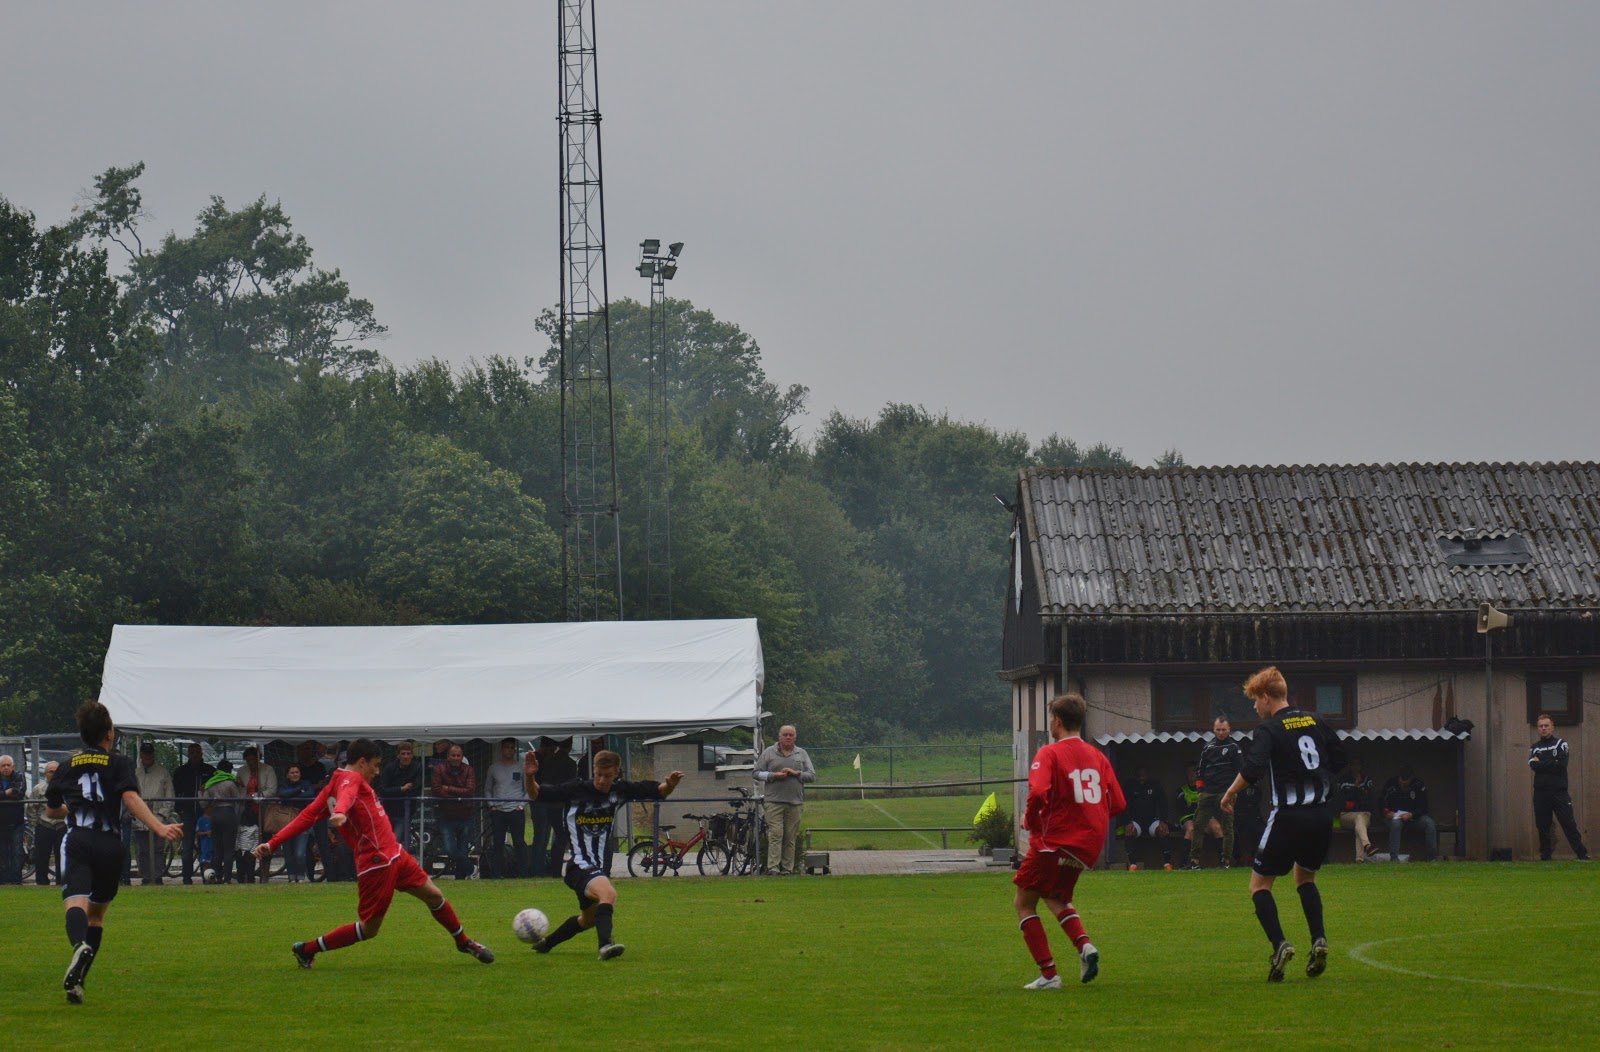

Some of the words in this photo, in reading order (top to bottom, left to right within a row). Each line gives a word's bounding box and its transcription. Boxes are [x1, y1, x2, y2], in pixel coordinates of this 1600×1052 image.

[71, 757, 108, 767] STESSENS
[1298, 735, 1320, 770] 8
[77, 772, 105, 802] 11
[1068, 768, 1102, 804] 13
